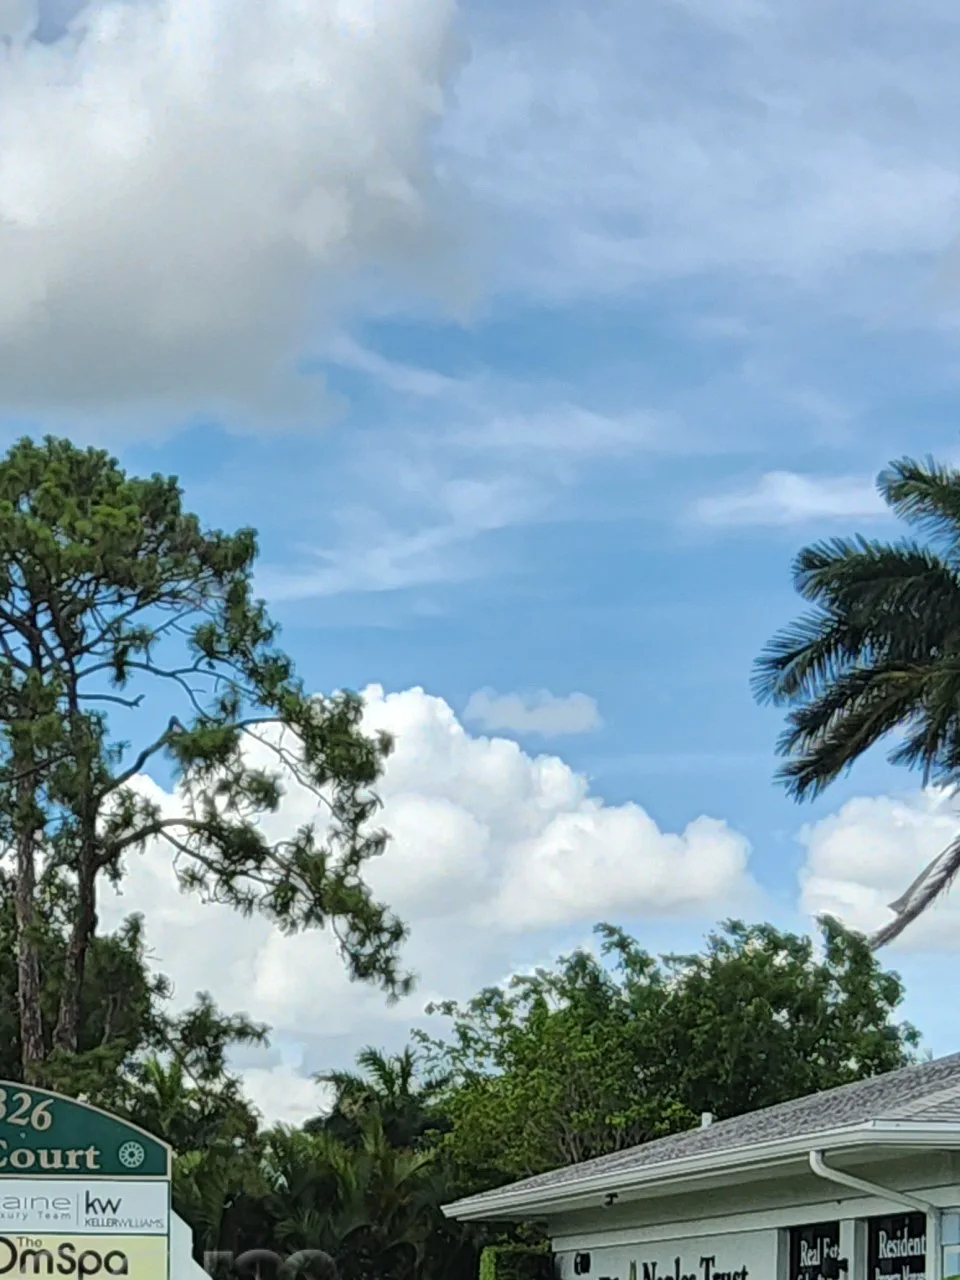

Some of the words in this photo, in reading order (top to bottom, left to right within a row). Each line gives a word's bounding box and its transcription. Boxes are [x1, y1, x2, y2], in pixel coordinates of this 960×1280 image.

[84, 1189, 122, 1215] kw
[38, 1211, 71, 1220] Team
[16, 1236, 43, 1248] The
[799, 1237, 821, 1267] Real
